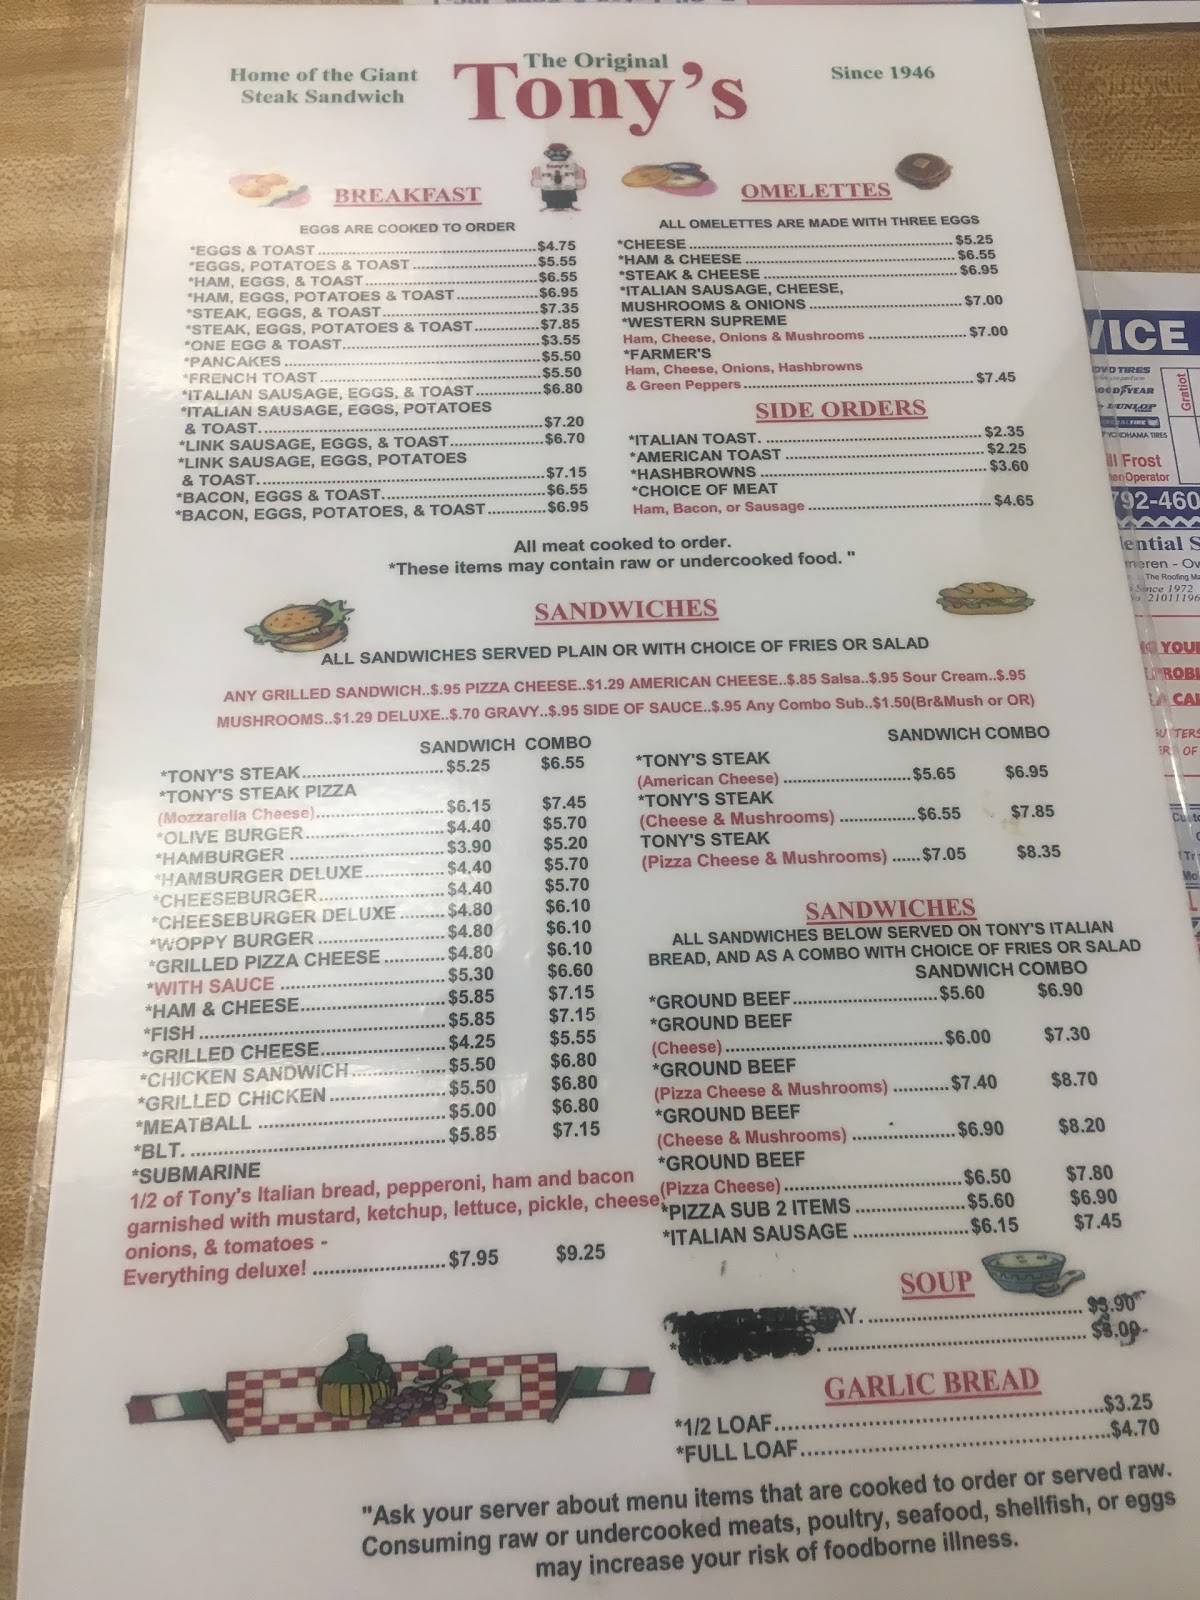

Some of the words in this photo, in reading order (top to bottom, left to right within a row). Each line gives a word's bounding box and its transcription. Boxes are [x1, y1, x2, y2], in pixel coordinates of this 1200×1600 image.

[524, 52, 567, 68] The
[574, 52, 668, 72] Original
[230, 67, 290, 82] Home
[296, 67, 319, 82] of
[322, 67, 354, 82] the
[360, 67, 418, 82] Giant
[831, 66, 883, 80] Since
[890, 65, 935, 80] 1946
[241, 89, 298, 104] Steak
[304, 89, 404, 104] Sandwich
[453, 61, 748, 137] Tony's
[335, 186, 482, 205] BREAKFAST
[740, 182, 891, 201] OMELETTES
[299, 224, 340, 234] EGGS
[344, 224, 373, 234] ARE
[377, 223, 439, 234] COOKED
[441, 222, 462, 233] TO
[464, 221, 516, 232] ORDER
[658, 219, 686, 229] ALL
[688, 218, 773, 229] OMELETTES
[776, 218, 805, 228] ARE
[808, 217, 849, 228] MADE
[851, 216, 887, 227] WITH
[890, 215, 938, 226] THREE
[940, 214, 980, 226] EGGS
[537, 240, 576, 253] $4.75
[538, 271, 578, 284] $6.55
[964, 294, 1003, 307] $7.00
[622, 333, 658, 345] Ham,
[661, 333, 716, 346] Cheese,
[719, 331, 768, 342] Onions
[771, 331, 782, 342] &
[785, 330, 865, 341] Mushrooms
[624, 364, 660, 380] Ham,
[663, 363, 718, 378] Cheese,
[721, 362, 774, 374] Onions,
[778, 361, 863, 373] Hashbrowns
[625, 380, 637, 391] &
[639, 380, 681, 391] Green
[684, 379, 742, 392] Peppers
[1177, 373, 1192, 412] Gratiot
[755, 401, 816, 423] SIDE
[817, 399, 928, 422] ORDERS
[1121, 453, 1162, 467] Frost
[1125, 471, 1170, 484] Operator
[513, 539, 536, 553] All
[542, 538, 585, 552] meat
[589, 536, 653, 551] cooked
[657, 536, 676, 549] to
[680, 535, 731, 549] order.
[454, 560, 503, 574] items
[508, 561, 544, 575] may
[549, 556, 614, 571] contain
[620, 558, 651, 569] raw
[656, 557, 675, 568] or
[680, 552, 793, 568] undercooked
[797, 551, 842, 565] food.
[1168, 584, 1193, 593] 1972
[534, 598, 720, 626] SANDWICHES
[320, 652, 355, 665] ALL
[359, 647, 477, 665] SANDWICHES
[481, 645, 552, 660] SERVED
[556, 643, 607, 658] PLAIN
[612, 643, 638, 657] OR
[642, 641, 686, 655] WITH
[690, 640, 756, 654] CHOICE
[760, 639, 783, 653] OF
[788, 638, 838, 652] FRIES
[842, 638, 868, 651] OR
[872, 636, 929, 650] SALAD
[887, 726, 981, 742] SANDWICH
[984, 725, 1050, 740] COMBO
[420, 737, 515, 754] SANDWICH
[524, 735, 592, 751] COMBO
[446, 758, 490, 774] $5.25
[540, 755, 584, 771] $6.55
[640, 833, 706, 848] TONY'S
[710, 830, 770, 847] STEAK
[642, 854, 692, 872] (Pizza
[696, 853, 760, 867] Cheese
[764, 850, 778, 865] &
[782, 848, 887, 866] Mushrooms)
[806, 897, 976, 924] SANDWICHES
[672, 932, 704, 946] ALL
[708, 928, 818, 945] SANDWICHES
[822, 926, 882, 941] BELOW
[887, 924, 953, 939] SERVED
[957, 923, 982, 937] ON
[984, 922, 1045, 936] TONY'S
[1049, 920, 1114, 935] ITALIAN
[130, 1191, 157, 1209] 1/2
[162, 1190, 184, 1208] of
[188, 1187, 252, 1208] Tony's
[258, 1184, 315, 1202] Italian
[321, 1179, 380, 1199] bread,
[386, 1174, 486, 1199] pepperoni,
[492, 1173, 532, 1189] ham
[537, 1170, 572, 1187] and
[577, 1169, 634, 1185] bacon
[448, 1248, 499, 1270] $7.95
[556, 1243, 606, 1264] $9.25
[900, 1270, 972, 1298] SOUP
[824, 1372, 935, 1403] GARLIC
[942, 1367, 1039, 1397] BREAD
[1102, 1392, 1153, 1415] $3.25
[362, 1503, 416, 1526] "Ask
[422, 1504, 474, 1528] your
[479, 1500, 550, 1520] server
[556, 1492, 620, 1516] about
[626, 1493, 688, 1512] menu
[694, 1487, 754, 1508] items
[759, 1482, 803, 1504] that
[809, 1483, 842, 1501] are
[849, 1473, 927, 1498] cooked
[932, 1473, 955, 1493] to
[960, 1468, 1017, 1491] order
[1023, 1470, 1046, 1487] or
[1051, 1460, 1122, 1485] served
[1128, 1462, 1172, 1479] raw.
[361, 1530, 491, 1557] Consuming
[498, 1531, 538, 1549] raw
[545, 1529, 569, 1547] or
[576, 1489, 721, 1545] undercooked
[728, 1513, 800, 1536] meats,
[807, 1508, 890, 1534] poultry,
[896, 1499, 988, 1525] seafood,
[995, 1493, 1091, 1518] shellfish,
[1097, 1494, 1119, 1511] or
[1124, 1490, 1176, 1513] eggs
[535, 1559, 582, 1582] may
[589, 1553, 684, 1576] increase
[690, 1549, 742, 1575] your
[748, 1542, 790, 1565] risk
[796, 1539, 818, 1562] of
[823, 1536, 936, 1560] foodborne
[942, 1531, 1018, 1552] illness.
